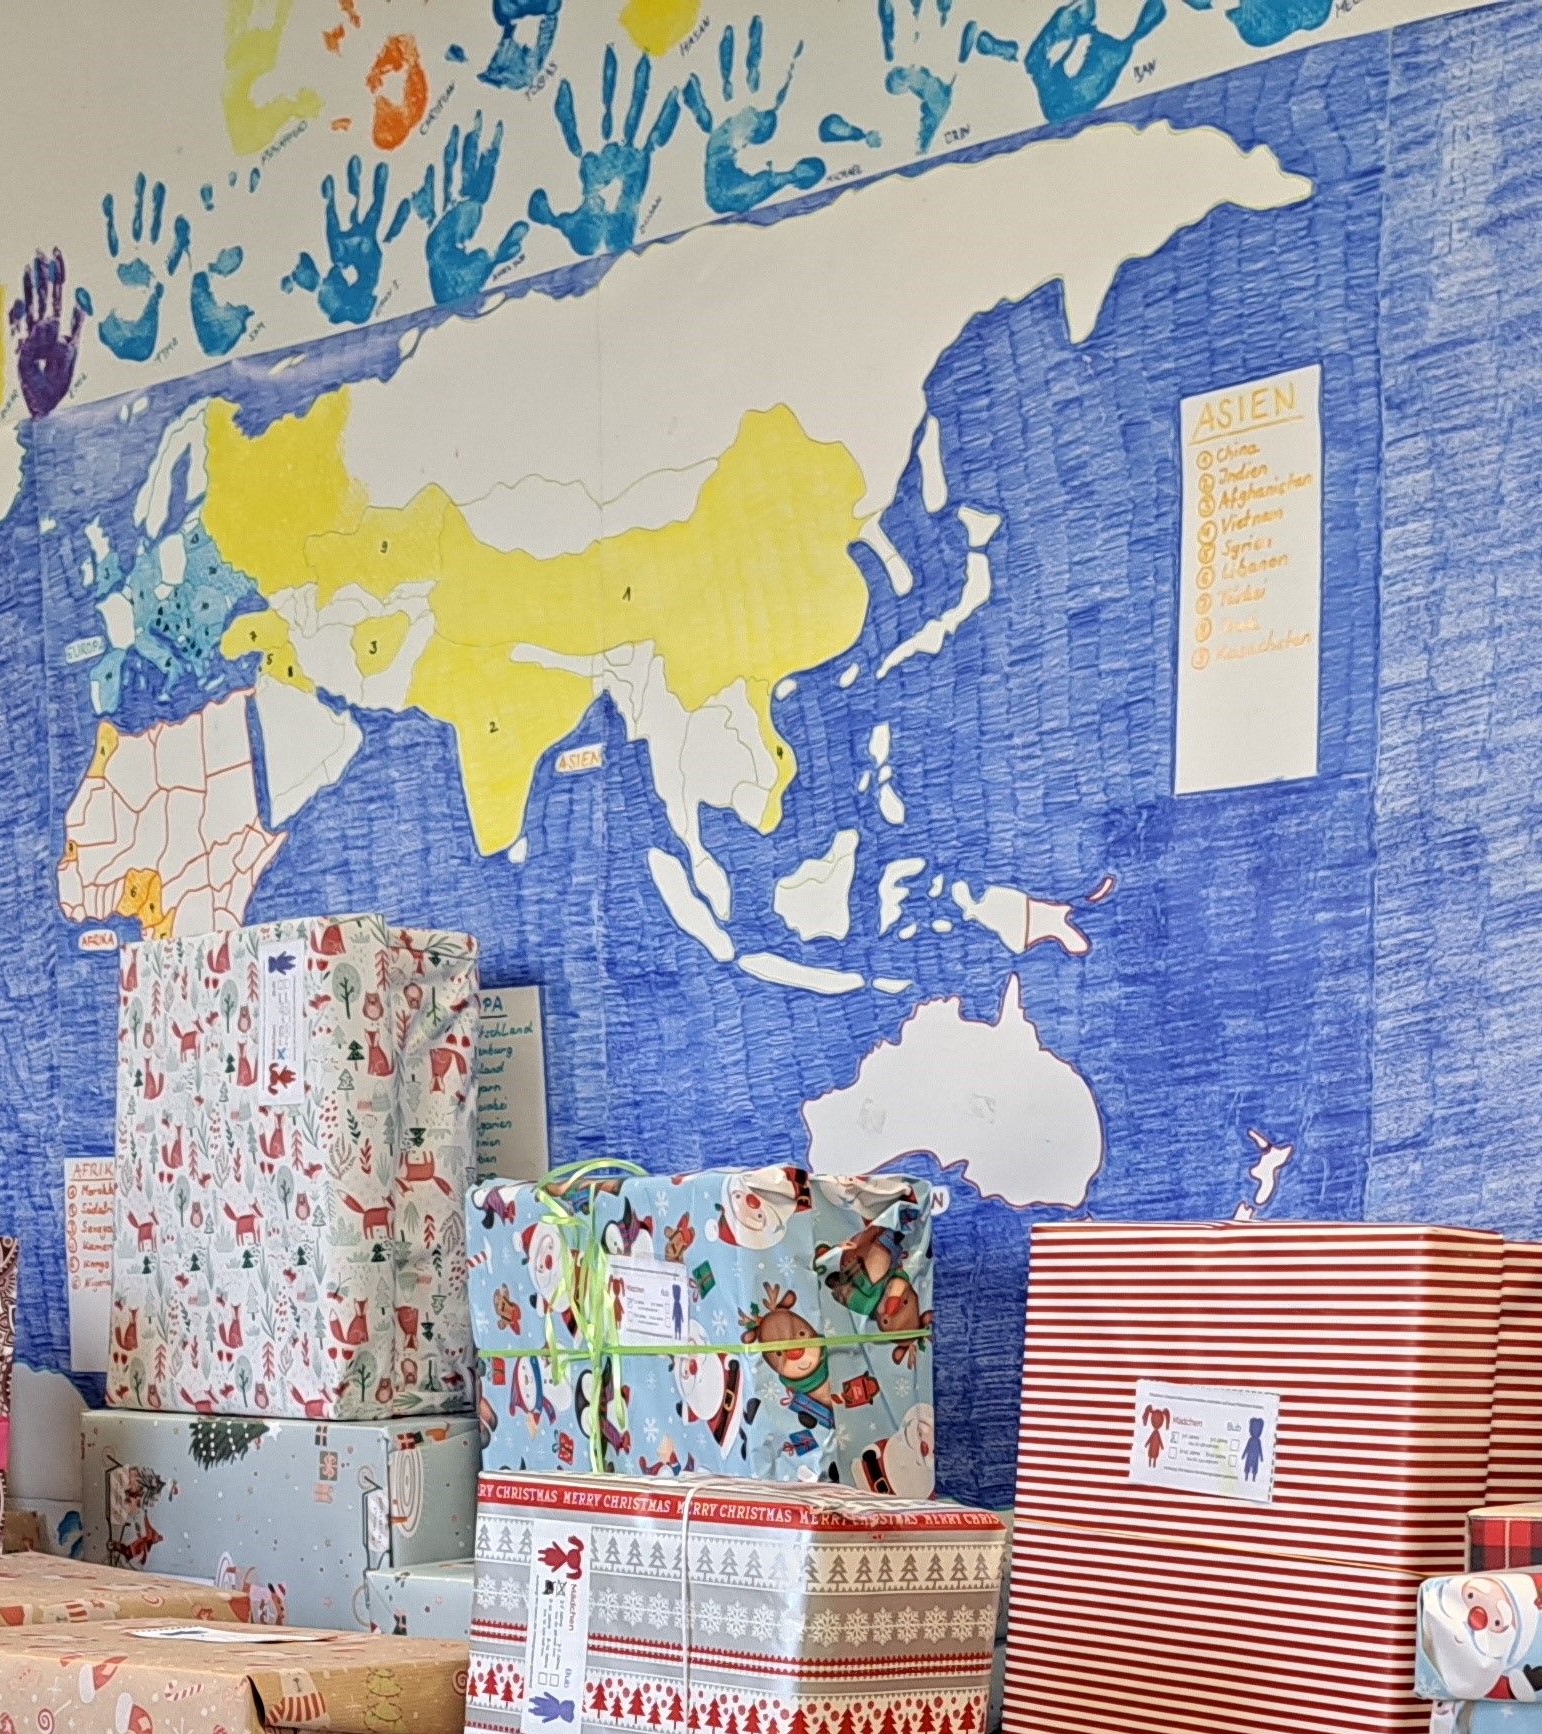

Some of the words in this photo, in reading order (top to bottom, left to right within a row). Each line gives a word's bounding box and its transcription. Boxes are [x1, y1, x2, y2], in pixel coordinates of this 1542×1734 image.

[1196, 382, 1296, 432] ASIEN
[1217, 442, 1260, 465] China
[1219, 462, 1268, 485] Indien
[495, 1485, 558, 1503] CHRISTMAS
[563, 1491, 602, 1508] MERRY
[603, 1494, 670, 1513] CHRISTMAS
[719, 1504, 792, 1524] CHRISTMAS
